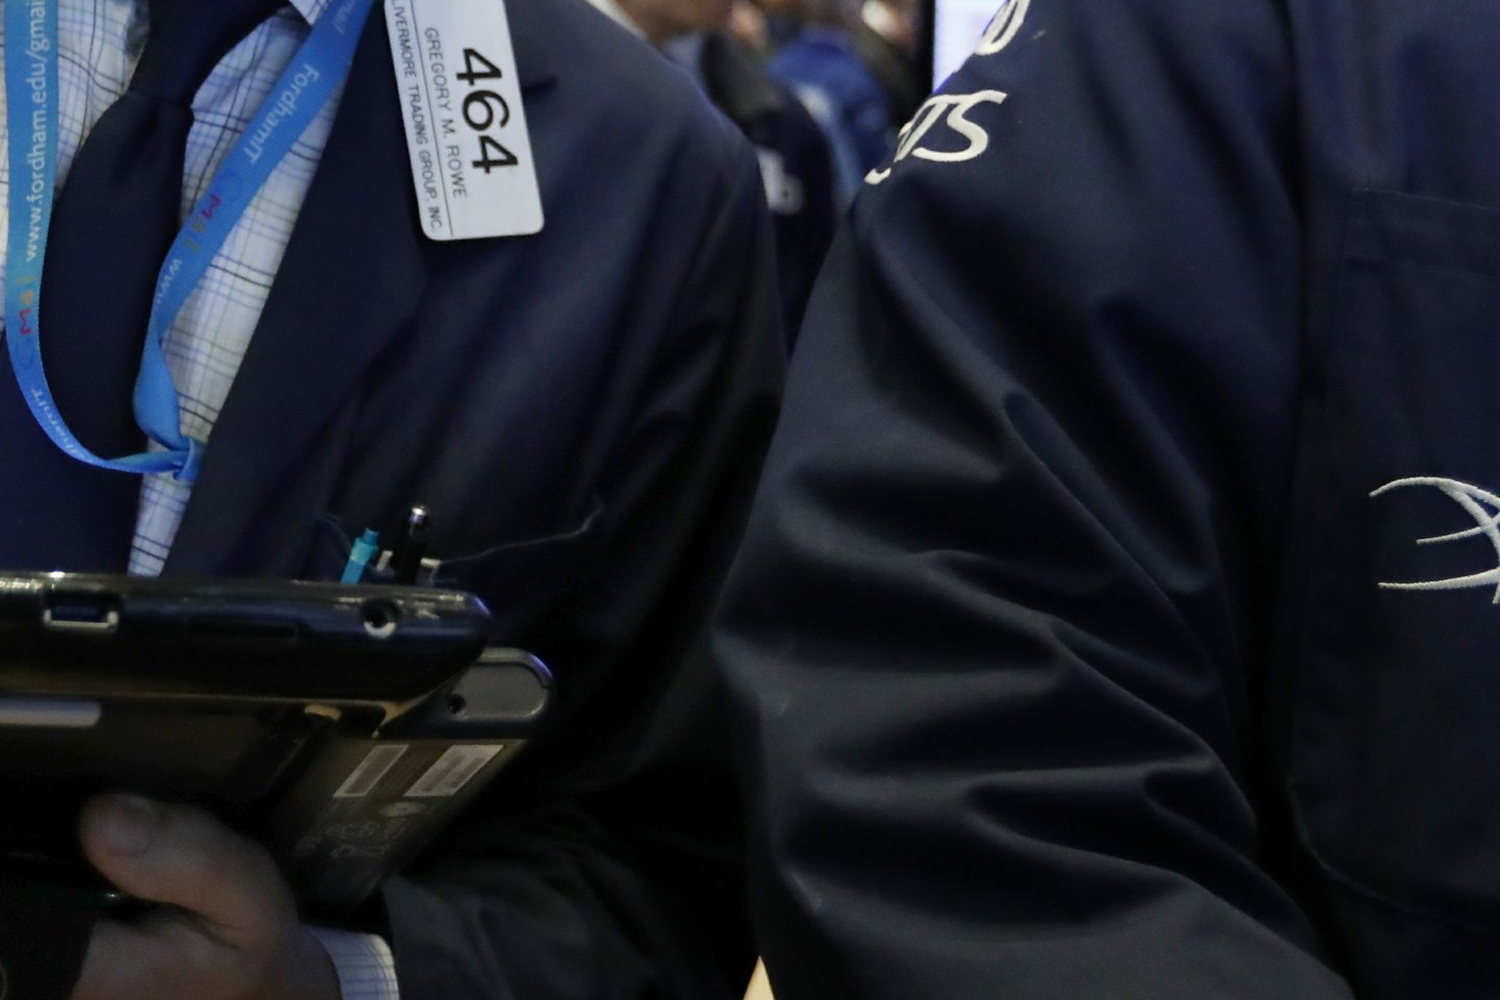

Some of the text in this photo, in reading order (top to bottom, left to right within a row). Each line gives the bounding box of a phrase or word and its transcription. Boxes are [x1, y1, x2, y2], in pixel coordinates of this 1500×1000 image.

[407, 85, 427, 145] TRADING
[425, 27, 451, 112] GREGORY
[446, 145, 467, 198] ROWE
[456, 48, 518, 174] 464
